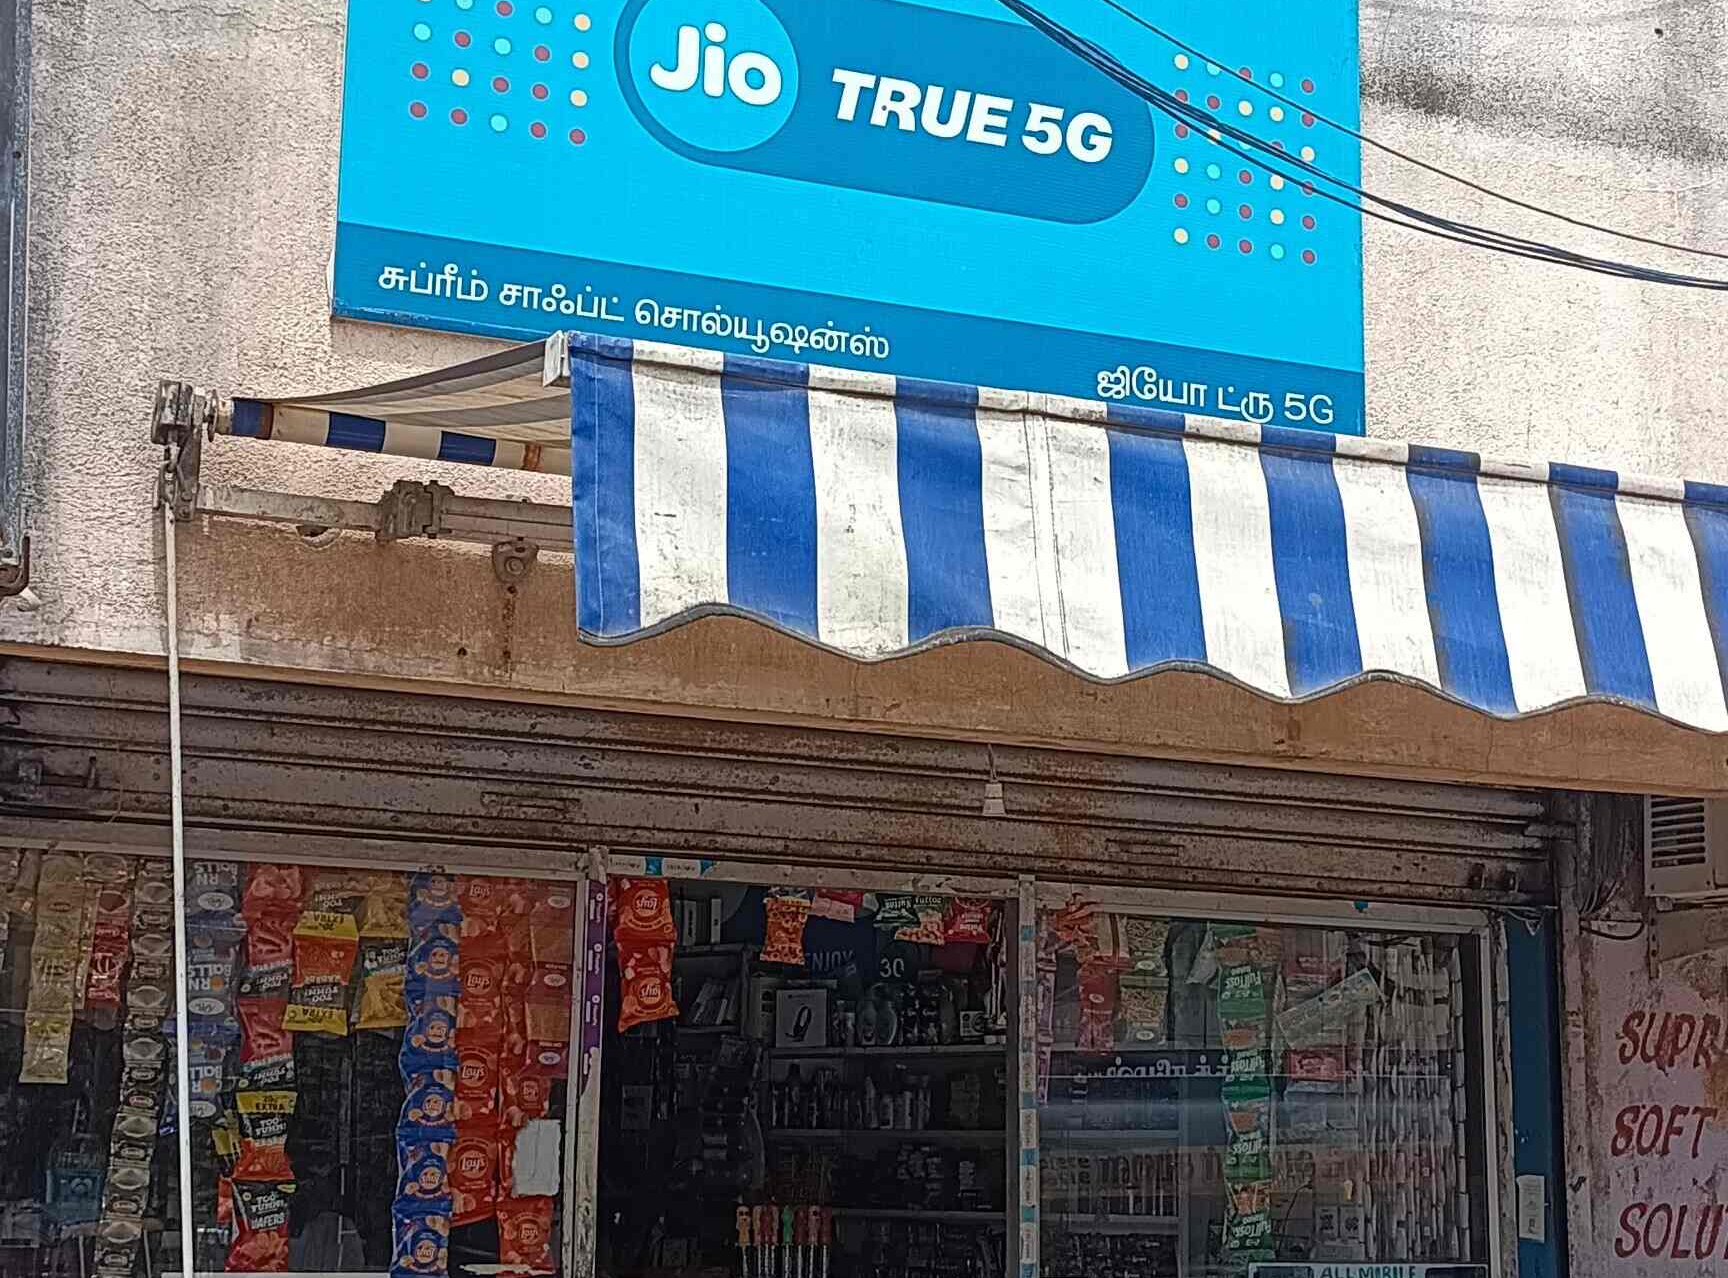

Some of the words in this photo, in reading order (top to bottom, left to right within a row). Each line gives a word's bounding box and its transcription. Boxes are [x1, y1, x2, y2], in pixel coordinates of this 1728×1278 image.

[649, 21, 783, 107] Jio
[831, 68, 1016, 147] TRUE
[1021, 101, 1114, 163] 5G
[378, 261, 489, 302] சுப்ரீம்
[499, 283, 625, 322] சாஃப்ட்
[634, 298, 889, 358] சொல்யூஷன்ஸ்
[1097, 365, 1207, 407] ஜியோ
[1284, 392, 1334, 425] 5G
[1611, 1105, 1718, 1159] SOFT
[461, 1156, 485, 1172] Lay's
[1614, 1202, 1728, 1260] SOLU
